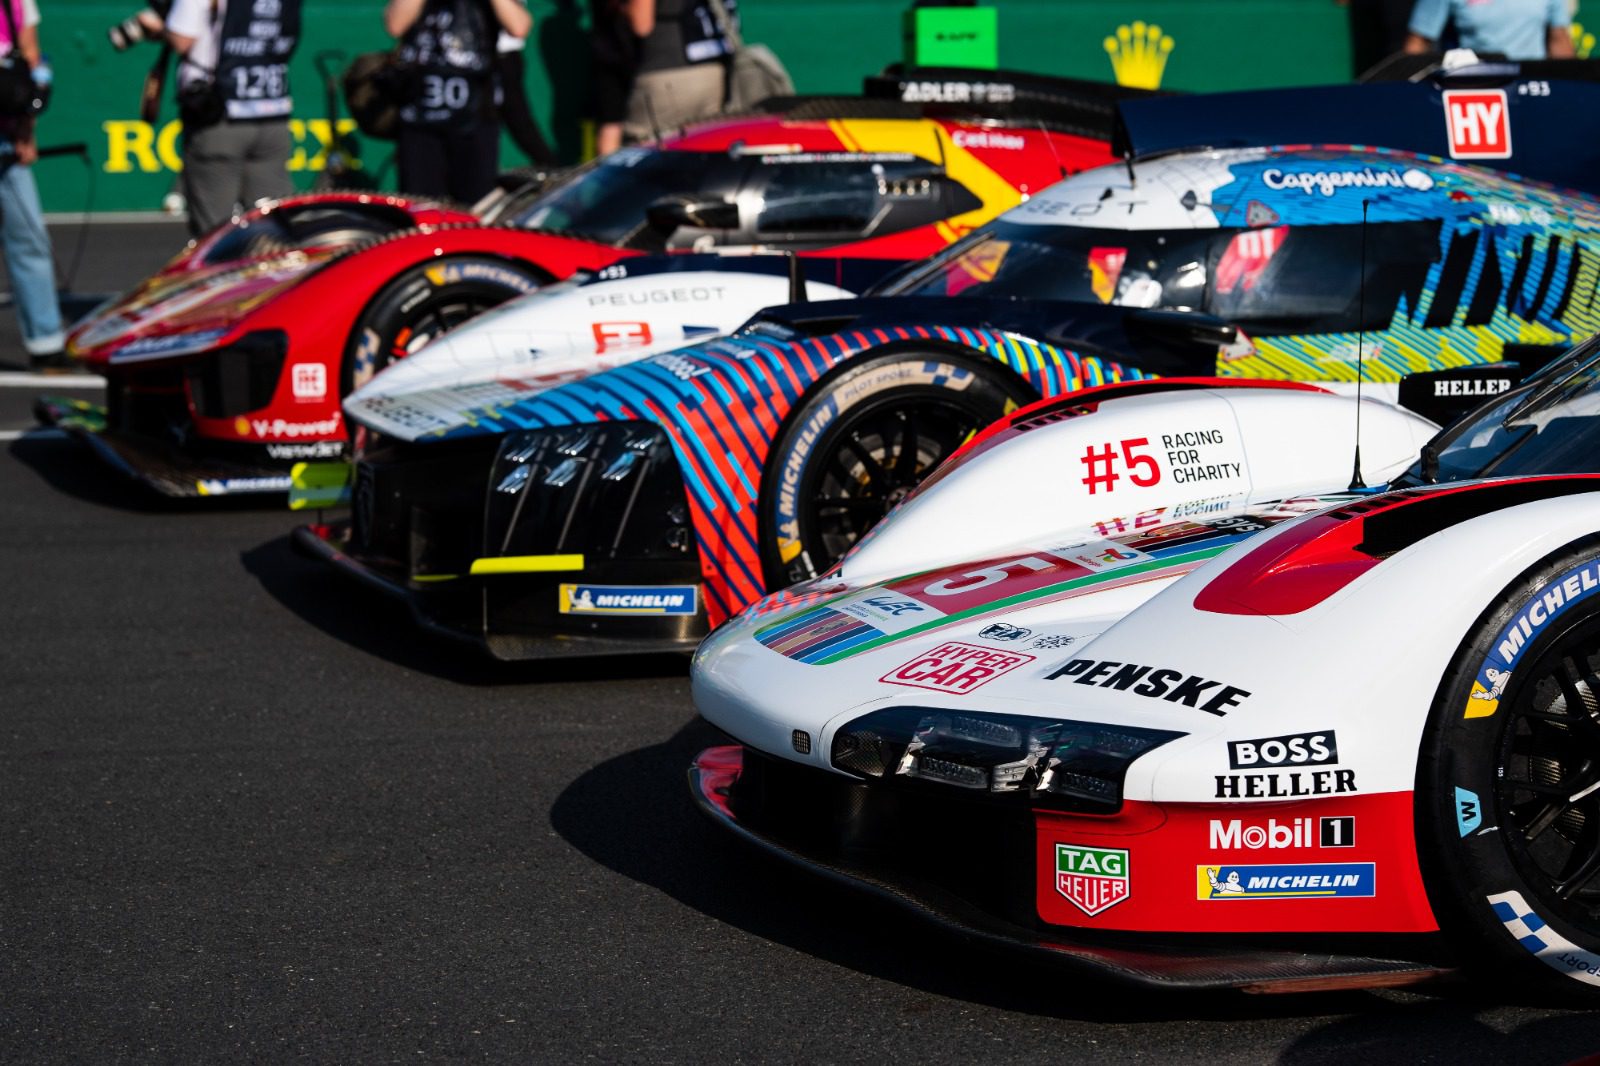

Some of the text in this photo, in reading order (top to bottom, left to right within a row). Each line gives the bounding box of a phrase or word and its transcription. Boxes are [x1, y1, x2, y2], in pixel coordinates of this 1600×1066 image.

[423, 75, 469, 109] 30
[902, 81, 971, 102] ADLER
[1449, 102, 1503, 145] HY
[103, 119, 361, 173] ROX
[1263, 168, 1403, 197] Capgemini
[588, 286, 726, 307] PEUGEOT
[1434, 379, 1511, 396] HELLER
[252, 418, 338, 438] V-Power
[1162, 429, 1224, 449] RACING
[779, 404, 833, 517] MICHELIN
[1080, 437, 1161, 495] #5
[1168, 449, 1201, 466] FOR
[1173, 463, 1241, 484] CHARITY
[597, 594, 684, 607] MICHELIN
[1498, 564, 1600, 665] MICHEL
[929, 645, 1021, 670] HYPER
[895, 657, 995, 690] CAR
[1044, 659, 1253, 717] PENSKE
[1235, 735, 1331, 766] BOSS
[1214, 768, 1358, 799] HELLER
[1209, 817, 1343, 850] Mobil 1
[1061, 849, 1122, 876] TAG
[1060, 875, 1126, 911] HEUER
[1247, 874, 1360, 890] MICHELIN
